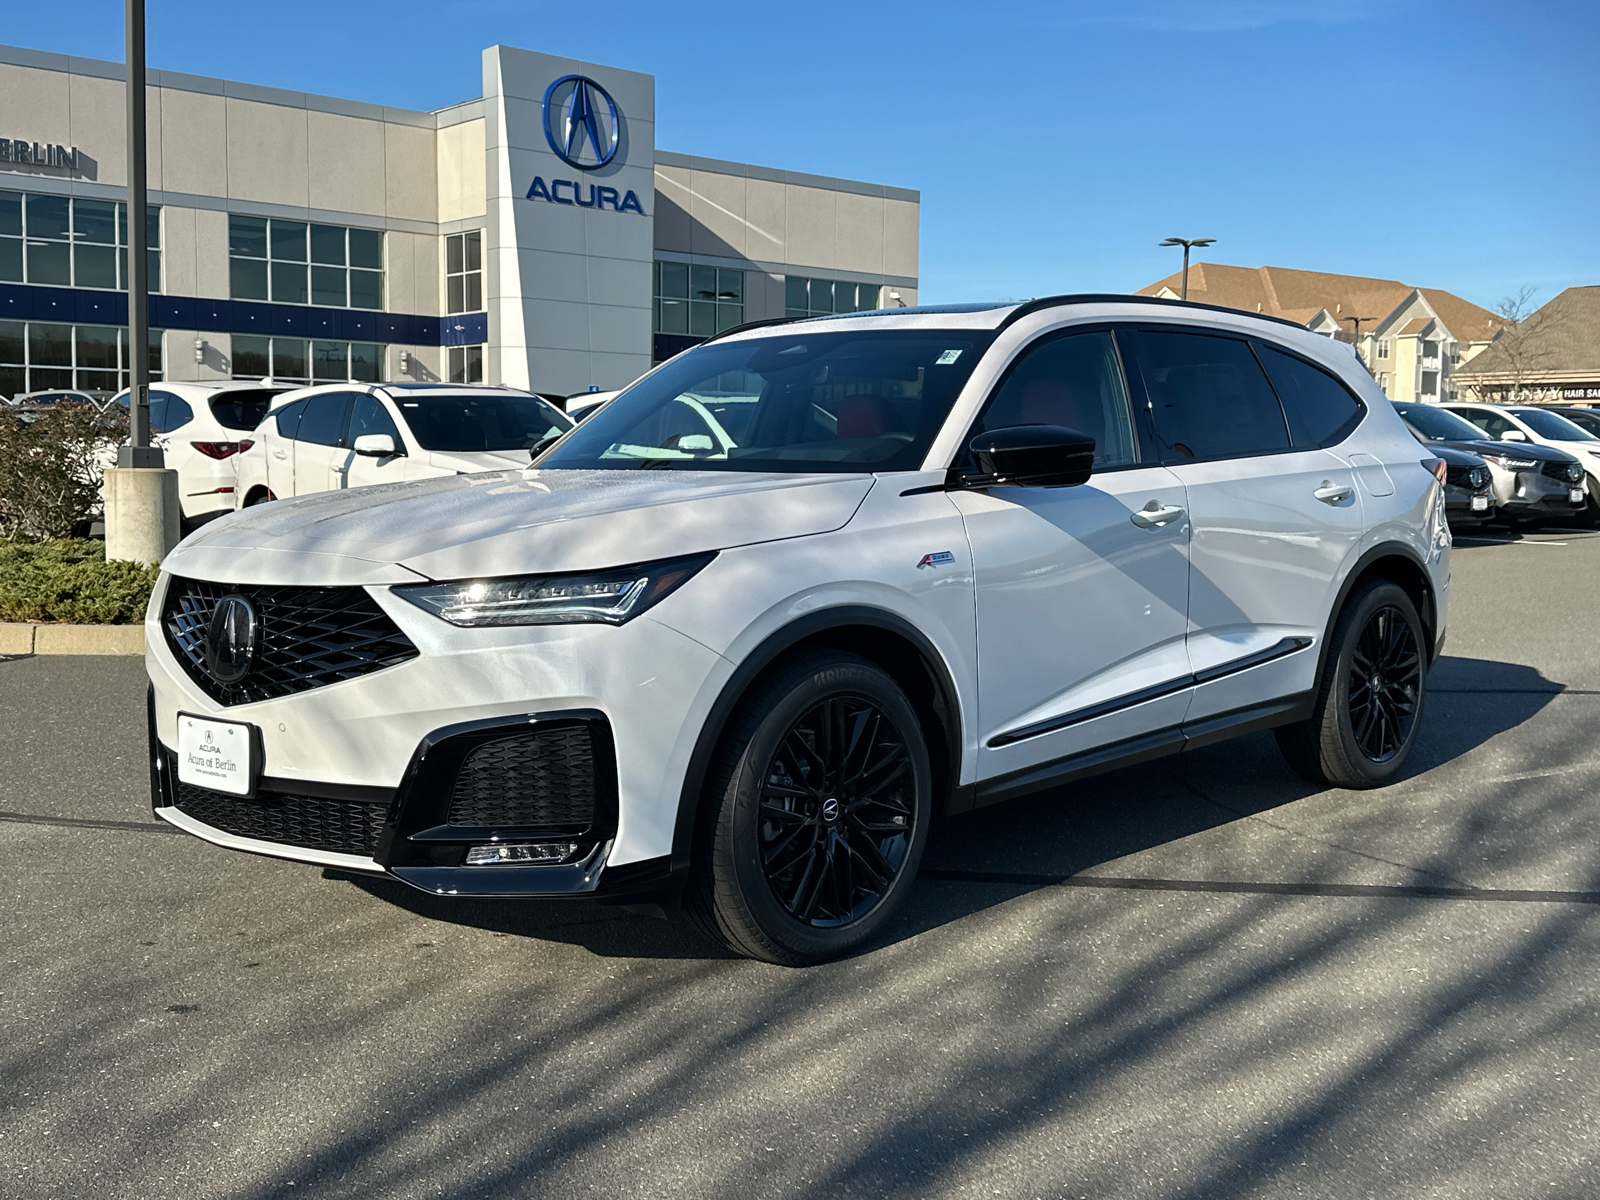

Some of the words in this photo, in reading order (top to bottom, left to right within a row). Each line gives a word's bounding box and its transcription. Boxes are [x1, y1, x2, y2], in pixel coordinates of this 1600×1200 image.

[525, 176, 644, 214] ACURA
[1564, 389, 1584, 398] HAIR
[199, 744, 221, 754] ACURA
[187, 753, 205, 766] Acura
[206, 757, 213, 768] of
[215, 757, 237, 772] Berlin
